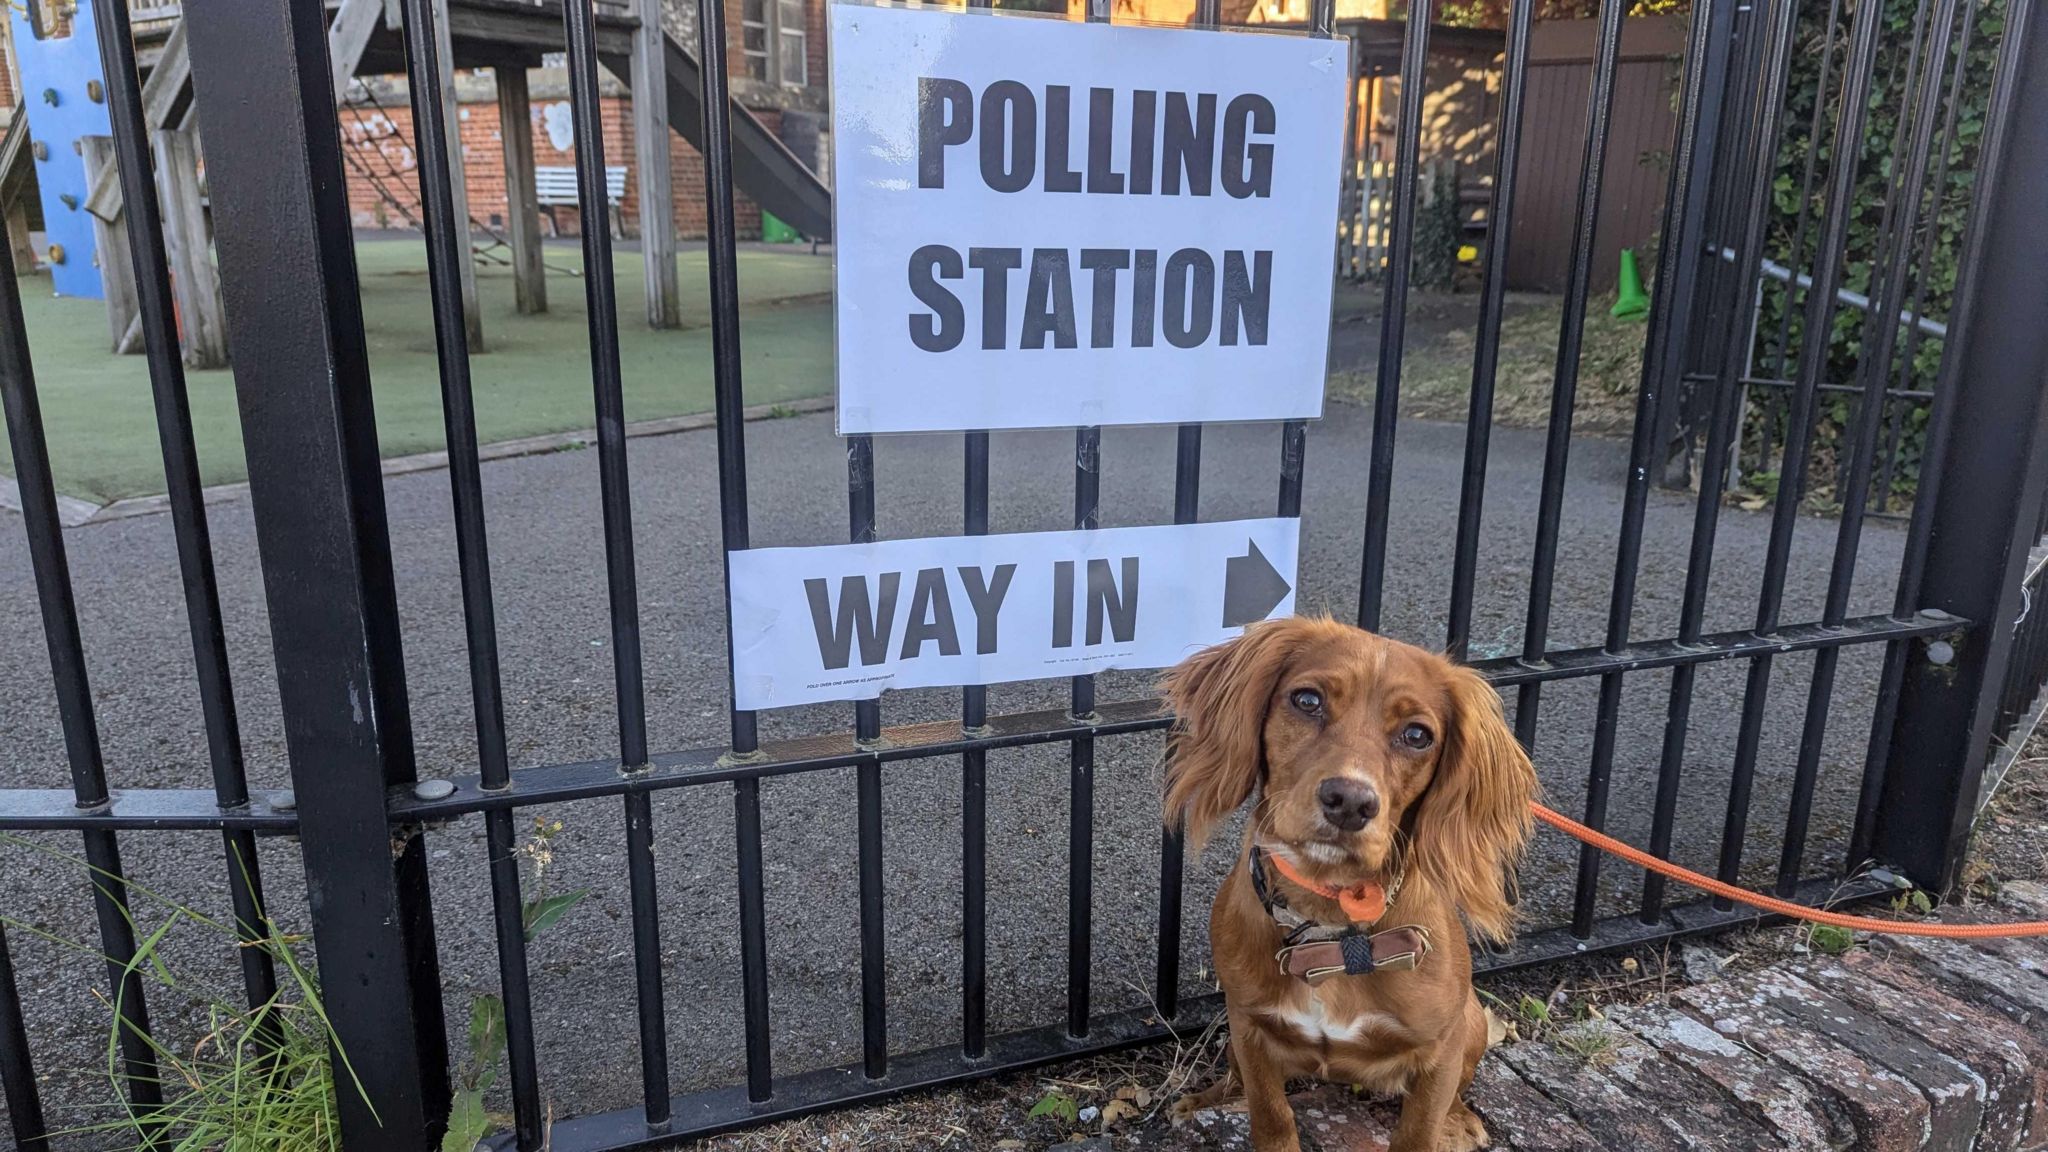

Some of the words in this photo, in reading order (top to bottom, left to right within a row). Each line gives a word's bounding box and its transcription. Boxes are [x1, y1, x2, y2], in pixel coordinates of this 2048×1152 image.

[917, 76, 1277, 199] POLLING
[907, 244, 1274, 353] STATION
[803, 563, 1018, 670] WAY
[1051, 556, 1140, 648] IN
